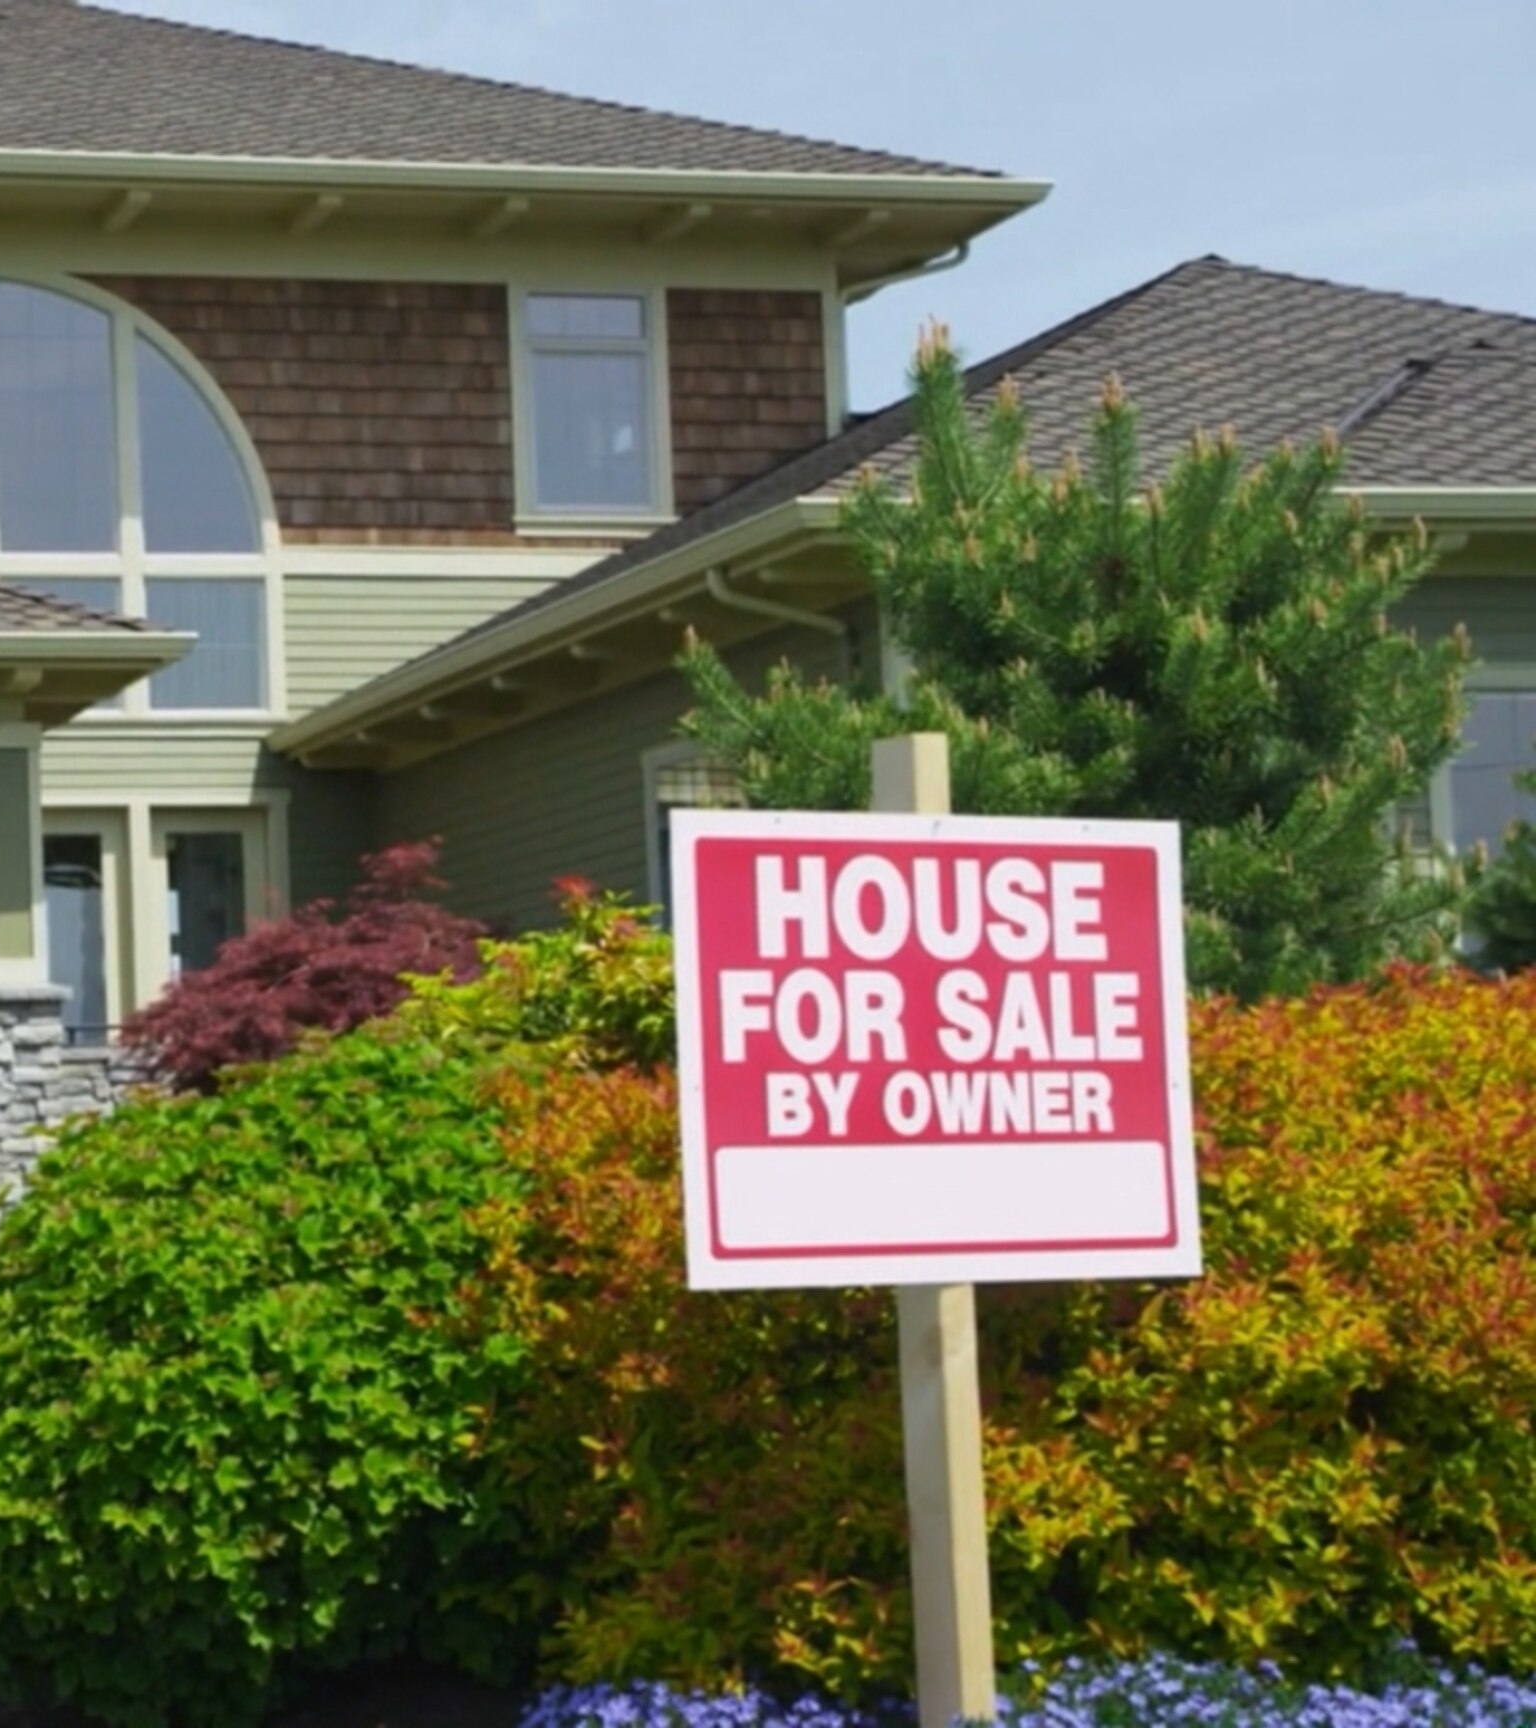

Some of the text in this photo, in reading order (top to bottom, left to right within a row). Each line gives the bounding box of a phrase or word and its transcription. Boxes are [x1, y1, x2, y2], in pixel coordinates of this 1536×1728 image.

[755, 854, 1108, 962] HOUSE
[718, 967, 1144, 1064] FOR SALE
[765, 1070, 1115, 1137] BY OWNER
